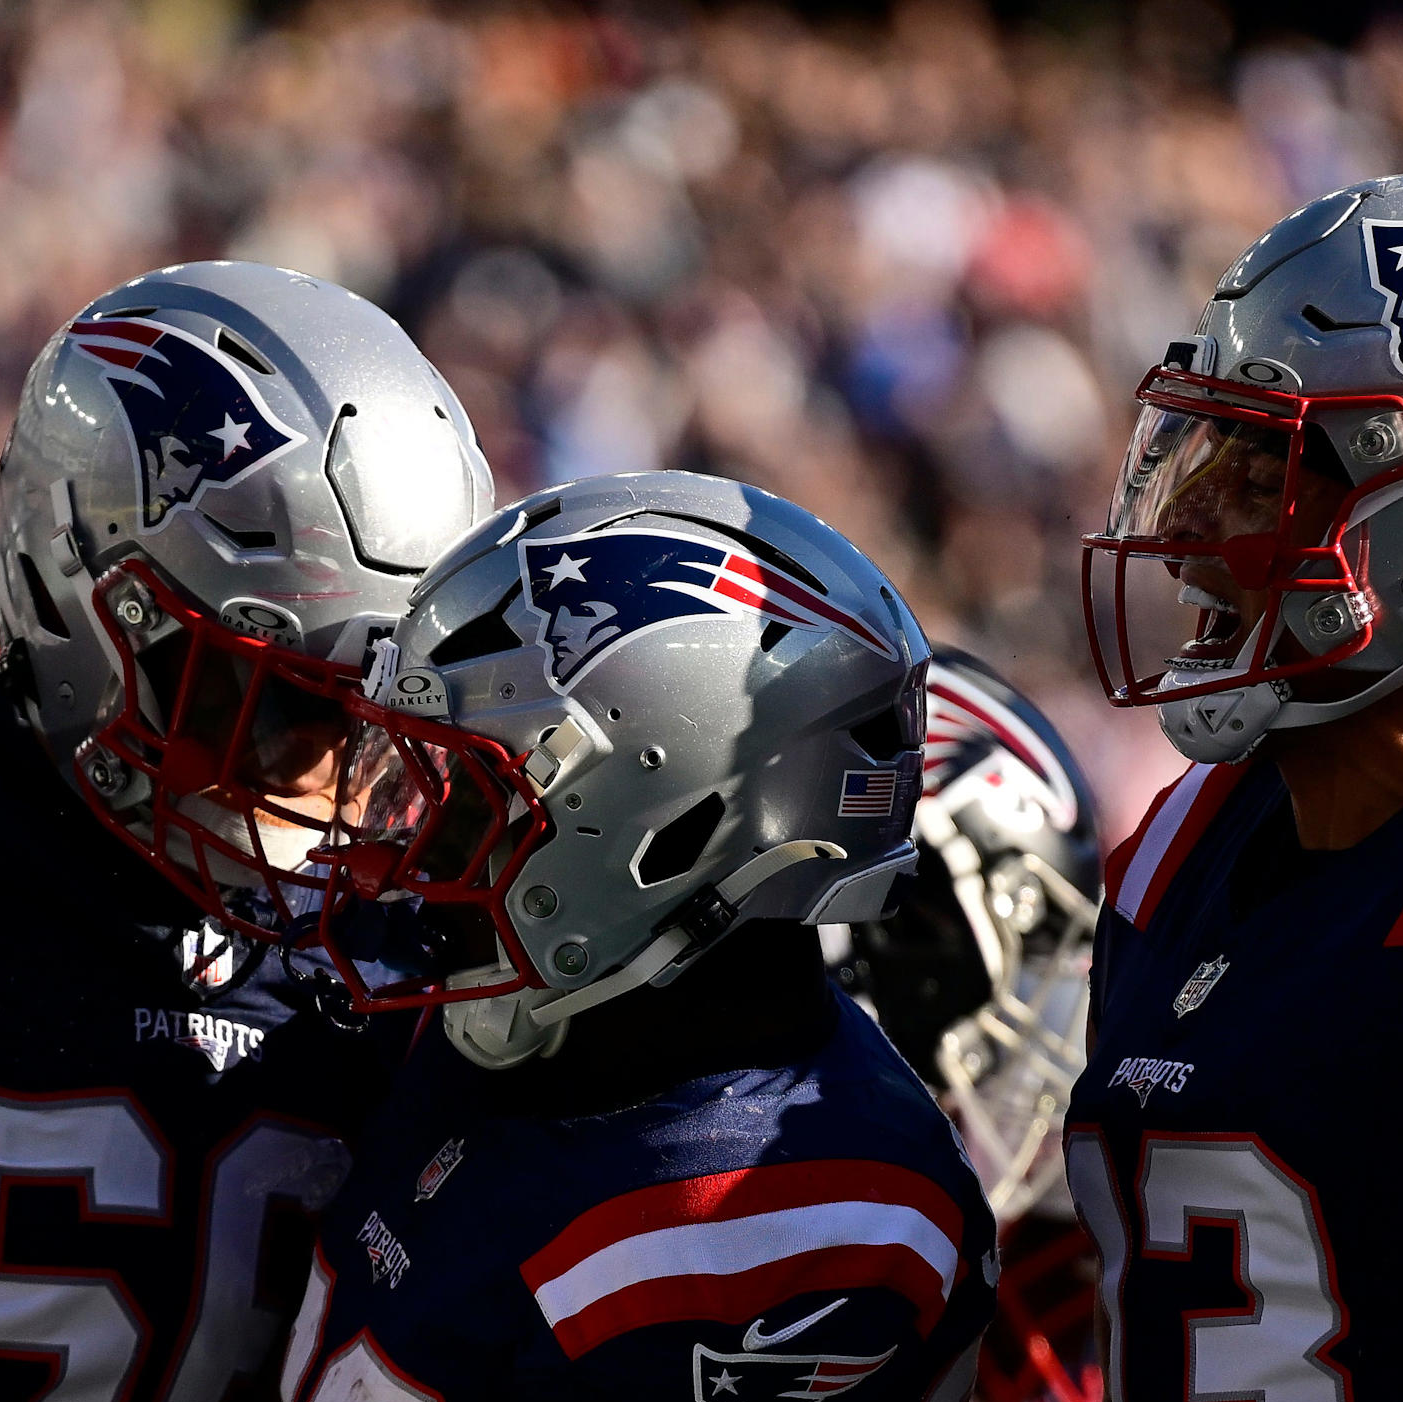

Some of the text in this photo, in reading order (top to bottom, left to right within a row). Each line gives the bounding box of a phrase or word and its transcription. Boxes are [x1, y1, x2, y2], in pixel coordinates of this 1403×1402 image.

[223, 614, 296, 647] OAKLEY
[391, 694, 445, 708] OAKLEY
[134, 1007, 266, 1064] PATRIOTS
[1107, 1056, 1195, 1094] PATRIOTS
[356, 1210, 411, 1290] PATRIOTS
